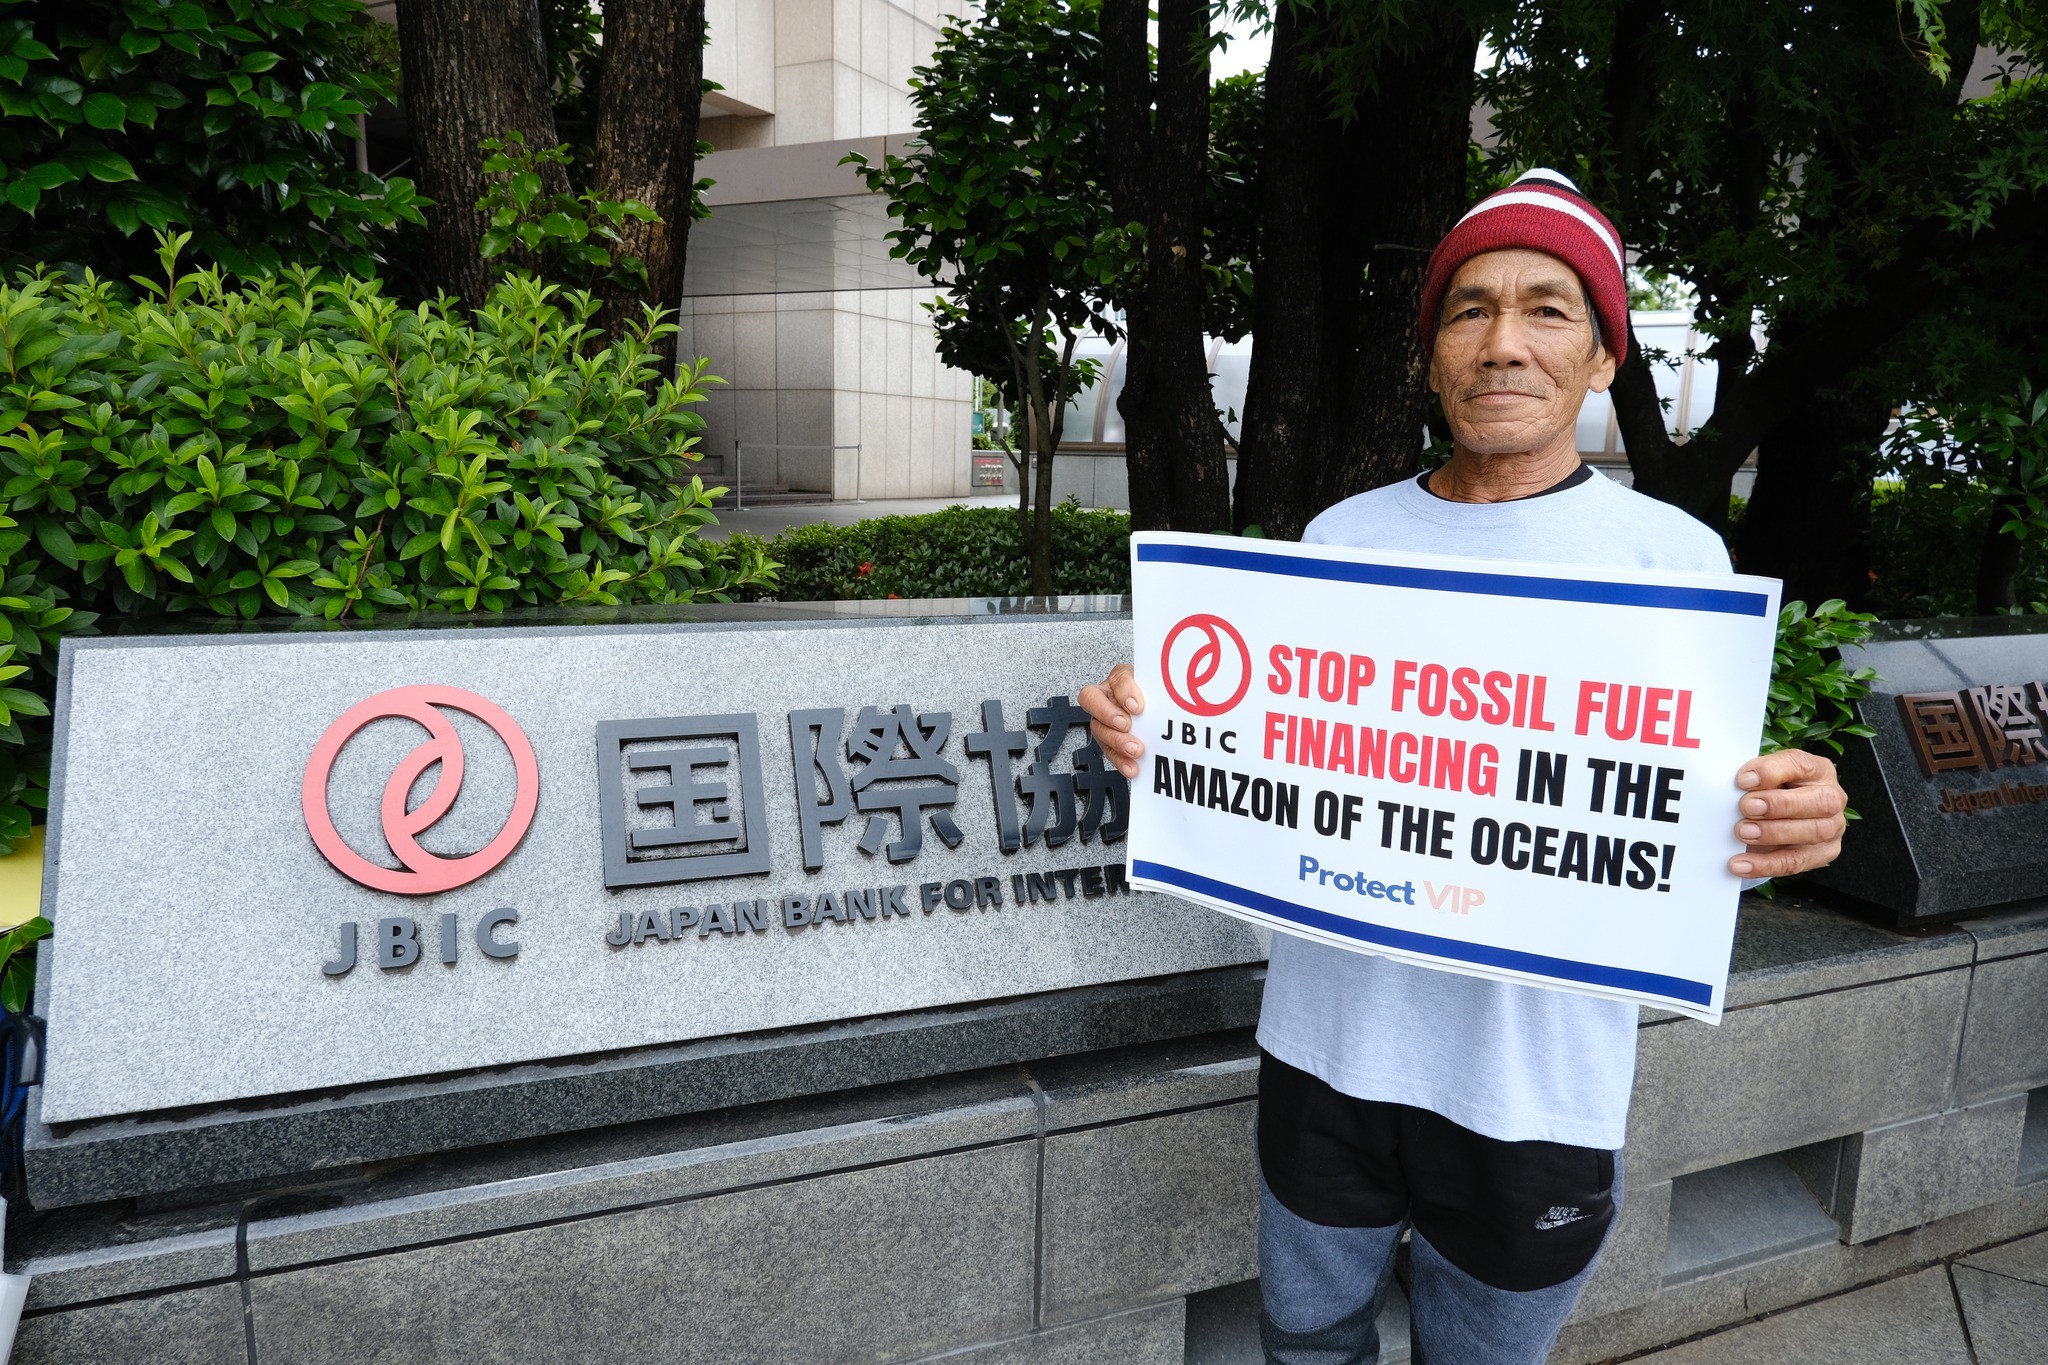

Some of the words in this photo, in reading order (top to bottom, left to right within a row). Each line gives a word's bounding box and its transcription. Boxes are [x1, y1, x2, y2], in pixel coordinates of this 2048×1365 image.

[1160, 718, 1237, 755] JBIC
[1267, 643, 1376, 706] STOP
[1391, 659, 1555, 732] FOSSIL
[1574, 680, 1701, 749] FUEL
[1894, 681, 2048, 776] 国際
[597, 695, 1131, 890] 国際協
[1263, 710, 1500, 798] FINANCING
[1515, 748, 1569, 808] IN
[1586, 757, 1685, 824] THE
[1937, 789, 2003, 815] Japan
[1153, 753, 1300, 830] AMAZON
[1313, 789, 1364, 841] OF
[1377, 799, 1456, 860] THE
[1470, 816, 1677, 893] OCEANS!
[606, 899, 769, 946] JAPAN
[783, 884, 910, 928] BANK
[919, 876, 1003, 911] FOR
[1012, 863, 1131, 905] INTER
[1298, 854, 1416, 906] Protect
[1422, 870, 1486, 915] VIP
[321, 907, 519, 976] JBIC
